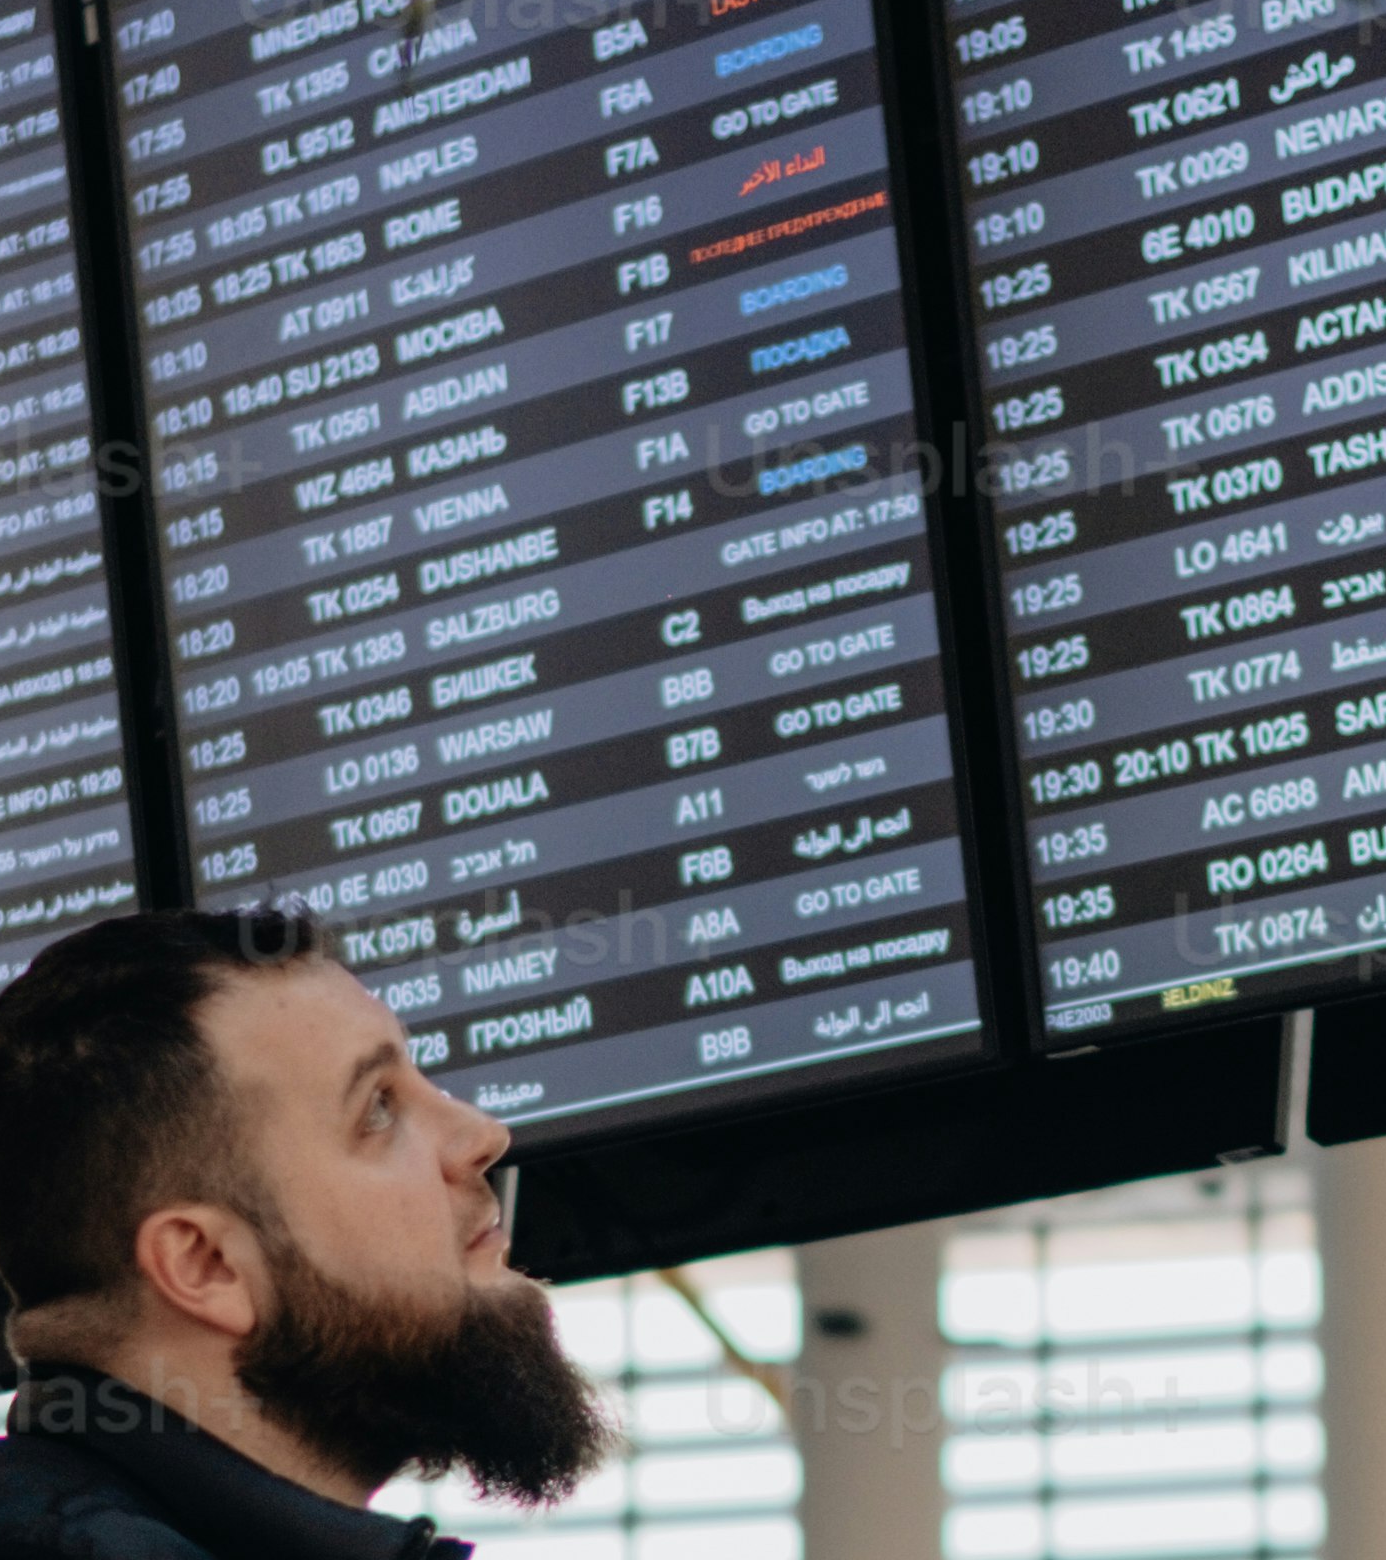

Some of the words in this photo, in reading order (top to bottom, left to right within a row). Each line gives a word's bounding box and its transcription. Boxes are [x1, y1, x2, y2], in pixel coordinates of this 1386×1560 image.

[982, 263, 1051, 307] 19:25
[415, 485, 508, 532] VIENNA
[1175, 540, 1218, 577] LO
[1222, 522, 1287, 563] 4641
[428, 589, 559, 647] SALZBURG
[662, 610, 700, 645] C2
[1025, 699, 1094, 739] 19:30
[1187, 666, 1230, 701] TK
[1233, 650, 1301, 692] 0774
[439, 710, 551, 761] WARSAW
[1115, 741, 1190, 785] 20:10
[1242, 713, 1308, 754] 1025
[445, 772, 548, 821] DOUALA
[1202, 793, 1245, 830] AC
[1208, 856, 1255, 892] RO
[1259, 841, 1327, 882] 0264
[1050, 948, 1121, 988] 19:40
[1214, 920, 1256, 955] TK
[1260, 906, 1327, 947] 0874
